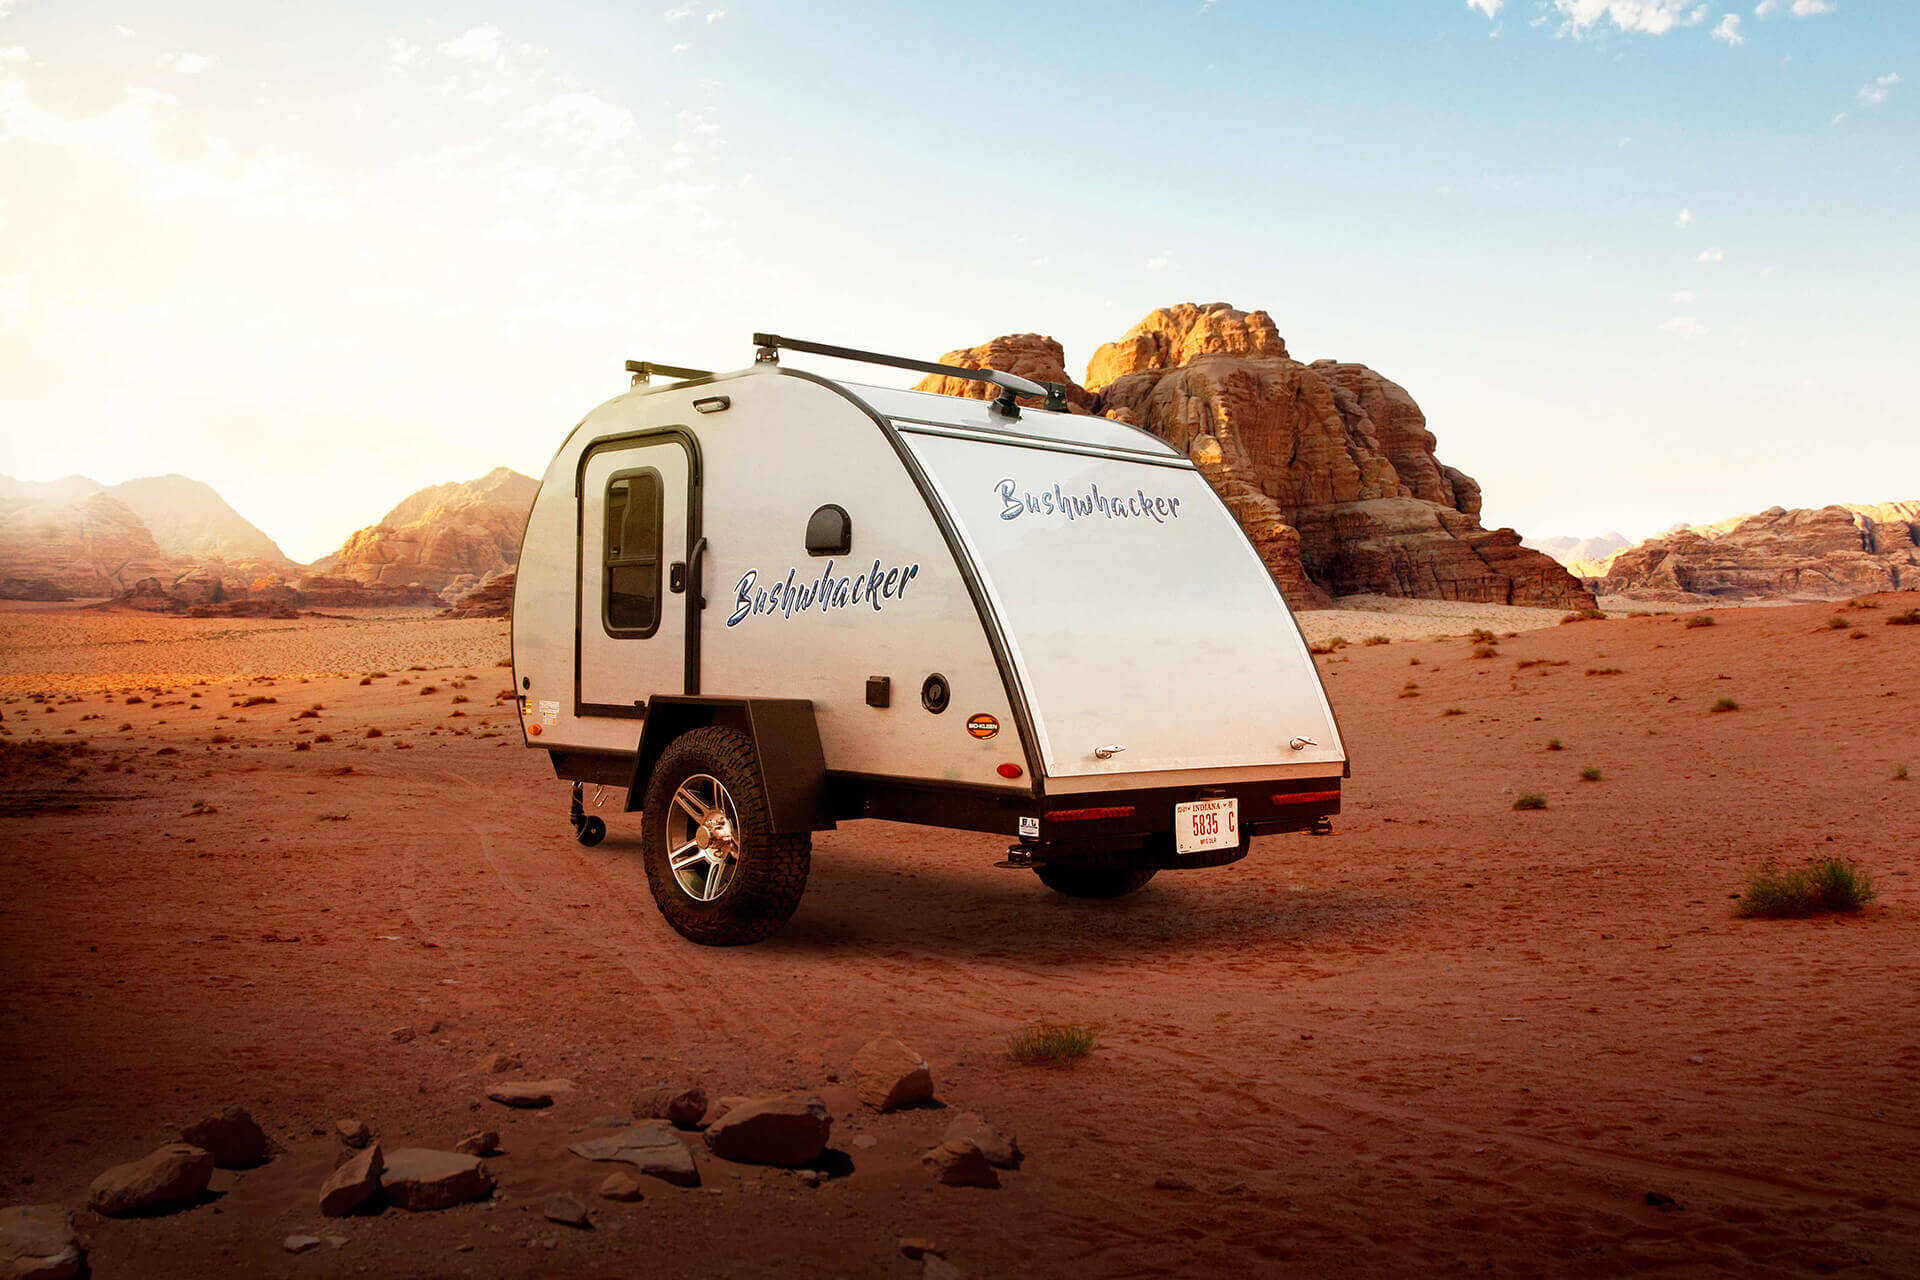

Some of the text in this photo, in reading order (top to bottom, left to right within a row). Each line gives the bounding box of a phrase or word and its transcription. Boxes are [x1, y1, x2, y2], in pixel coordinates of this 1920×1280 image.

[993, 477, 1181, 525] Bushwhacker
[726, 557, 920, 629] Bushwhacker
[1192, 803, 1221, 812] INDIANA
[1192, 811, 1235, 836] 5835 C
